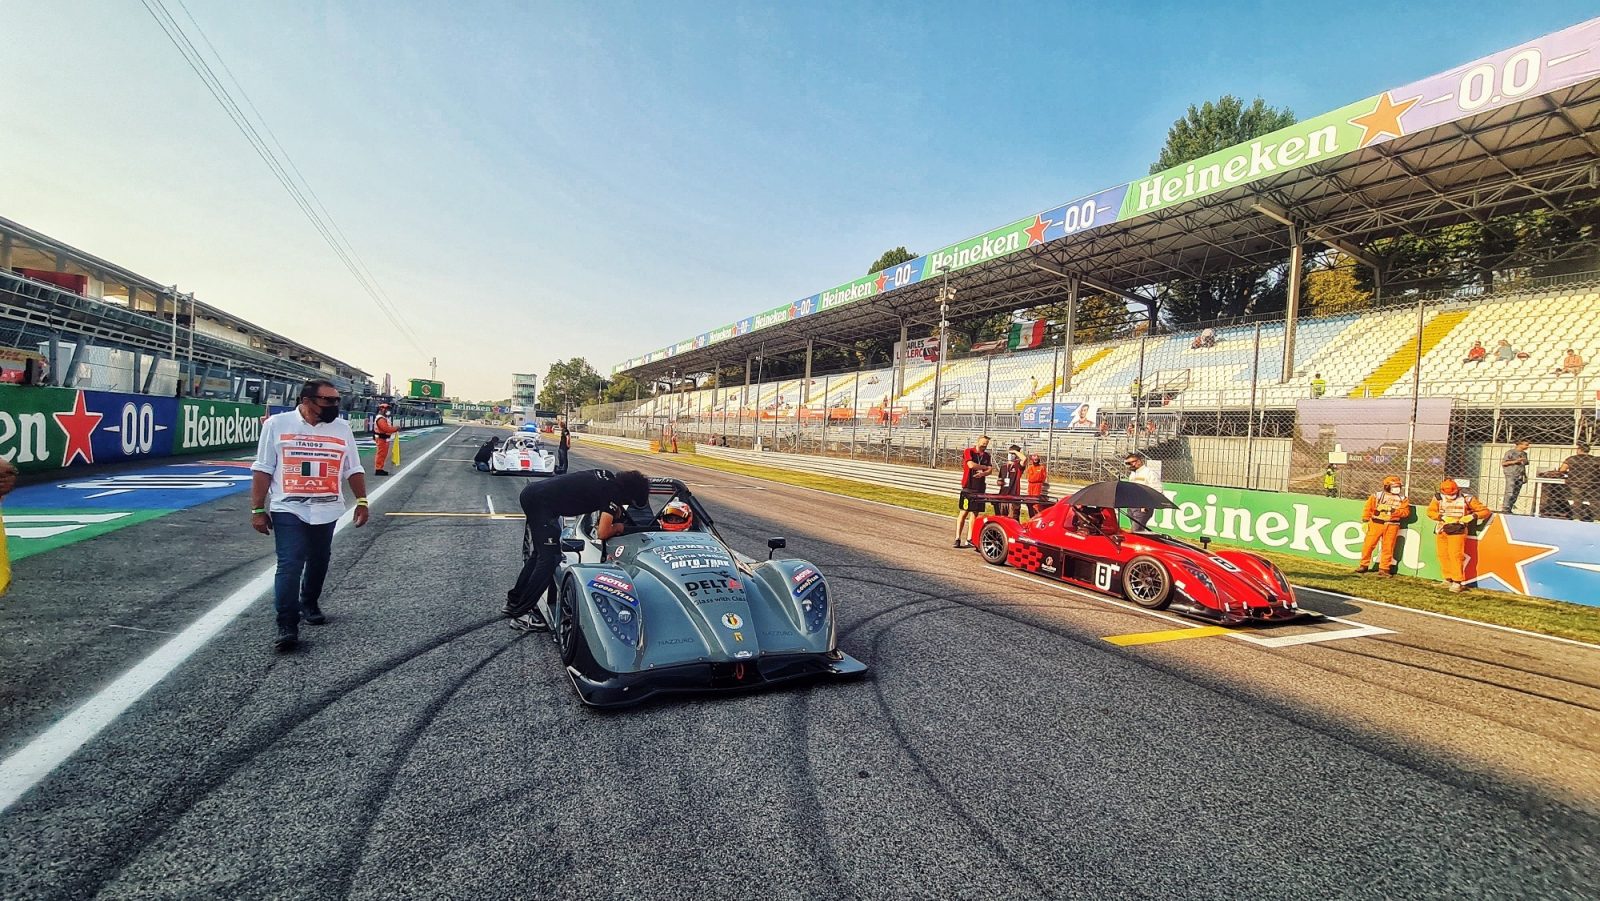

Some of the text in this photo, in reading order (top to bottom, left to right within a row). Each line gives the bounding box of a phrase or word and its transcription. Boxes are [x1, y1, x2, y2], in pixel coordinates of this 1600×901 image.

[1457, 46, 1543, 113] 0.0
[1136, 121, 1339, 213] Heineken
[1063, 199, 1098, 235] 0.0
[930, 230, 1020, 275] Heineken
[821, 279, 872, 309] Heineken
[754, 308, 787, 330] Heineken
[451, 402, 491, 412] Heineken
[121, 401, 154, 456] 0.0
[182, 404, 260, 448] Heineken
[597, 575, 629, 590] MOTUL
[684, 579, 743, 592] DELTA
[794, 569, 812, 582] MOTUL
[592, 583, 635, 602] GOODYEAR
[689, 588, 745, 597] GLASS
